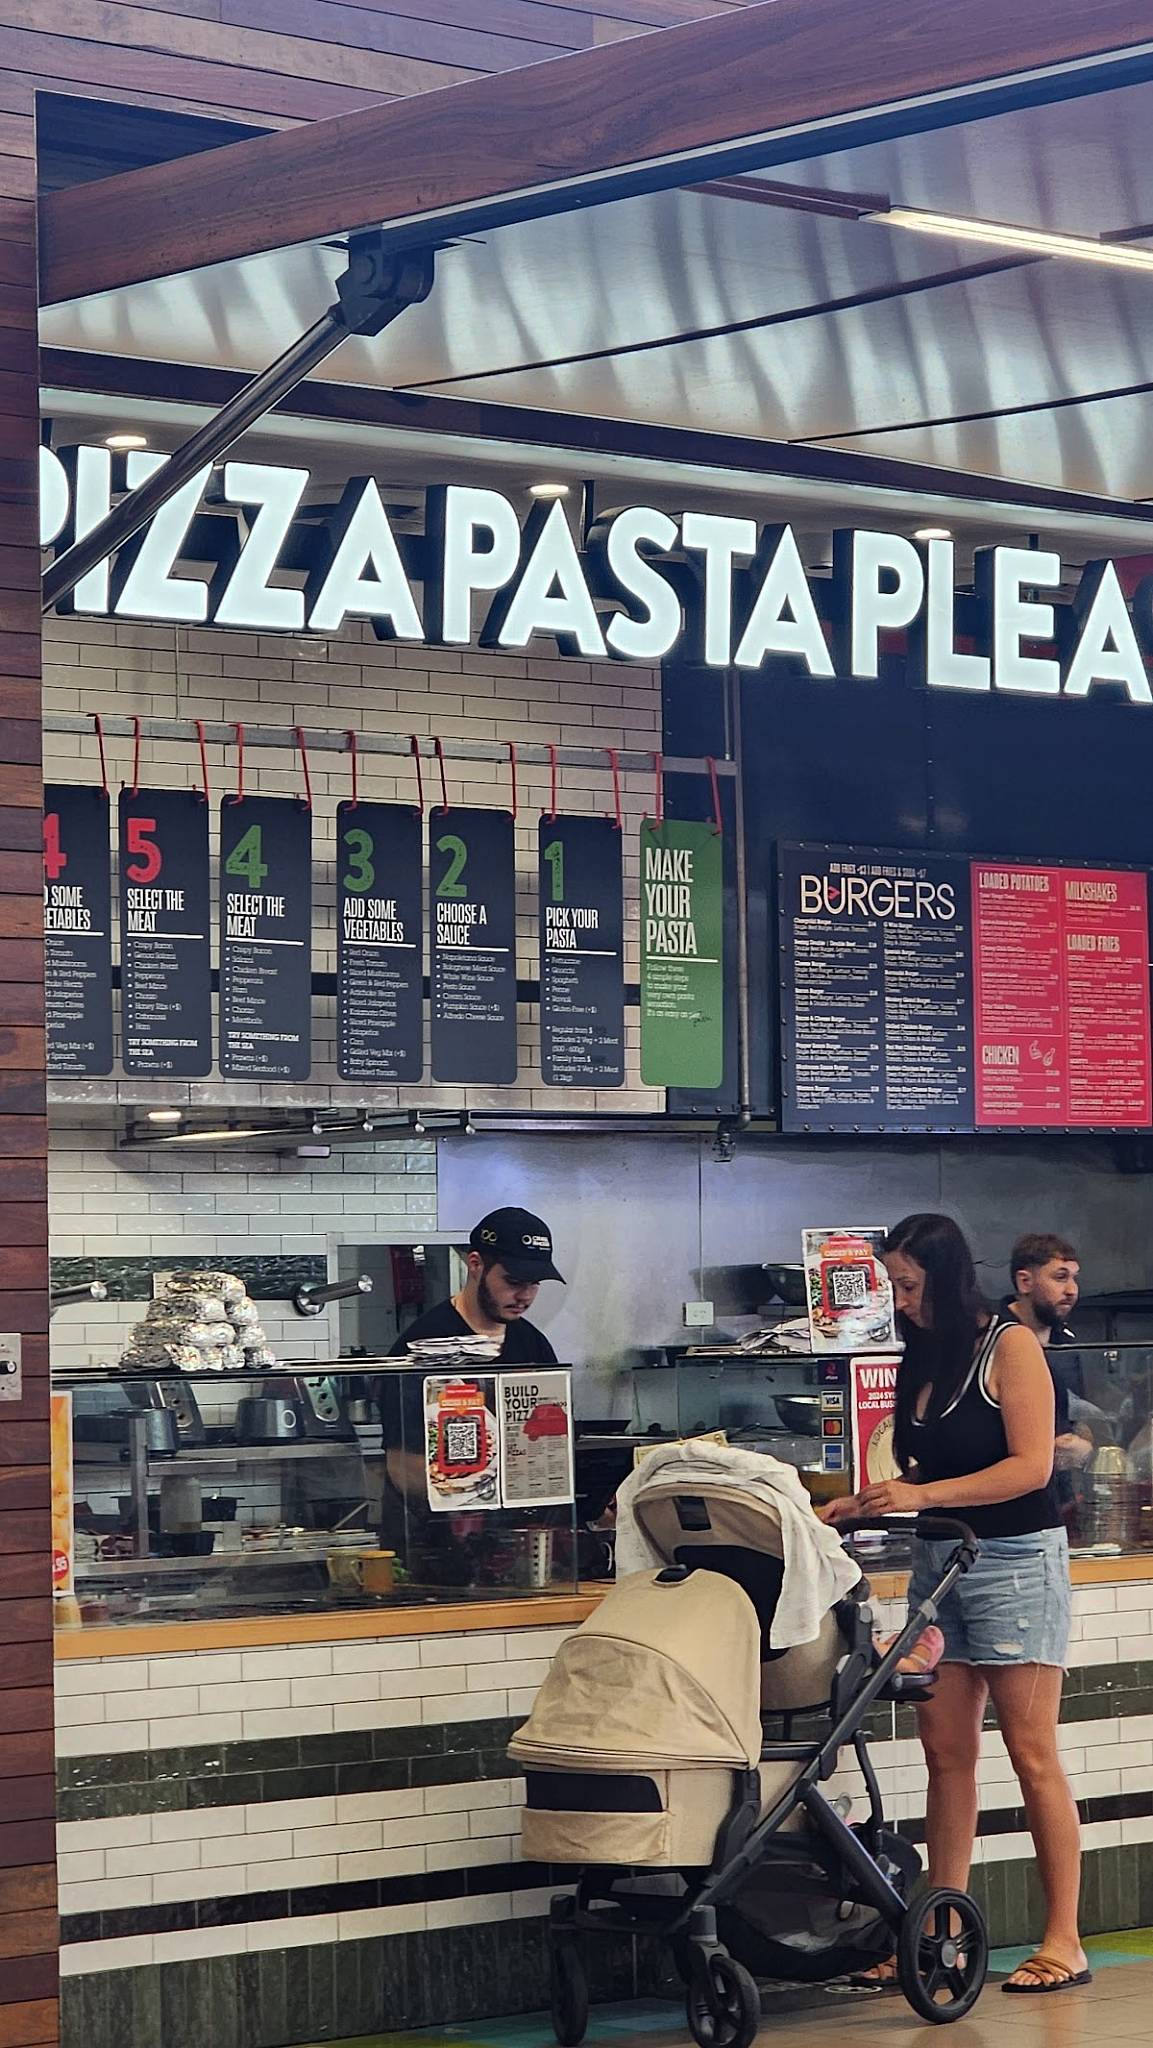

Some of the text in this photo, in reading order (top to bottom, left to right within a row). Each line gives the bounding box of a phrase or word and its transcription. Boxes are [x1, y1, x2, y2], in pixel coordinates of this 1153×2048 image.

[443, 486, 836, 678] PASTA
[126, 818, 162, 884] 5
[225, 824, 268, 889] 4
[343, 829, 374, 892] 3
[436, 835, 468, 897] 2
[544, 841, 563, 901] 1
[645, 848, 694, 882] MAKE
[979, 872, 1009, 889] LOADED
[1065, 881, 1117, 902] MILKSHAKES
[51, 886, 83, 908] SOME
[127, 889, 184, 911] SELECT THE
[227, 893, 285, 917] SELECT THE
[645, 884, 691, 918] YOUR
[801, 875, 956, 920] BURGERS
[344, 898, 397, 920] ADD SOME
[437, 903, 487, 925] CHOOSE A
[546, 907, 598, 928] PICK YOUR
[128, 912, 157, 932] MEAT
[227, 916, 257, 937] MEAT
[344, 920, 404, 942] VEGETABLES
[437, 924, 470, 944] SAUCE
[546, 928, 577, 948] PASTA
[646, 920, 697, 954] PASTA
[1067, 934, 1120, 952] LOADED FRIES
[982, 1046, 1019, 1065] CHICKEN
[860, 1368, 897, 1388] WIN
[504, 1385, 539, 1398] BUILD
[504, 1398, 537, 1410] YOUR
